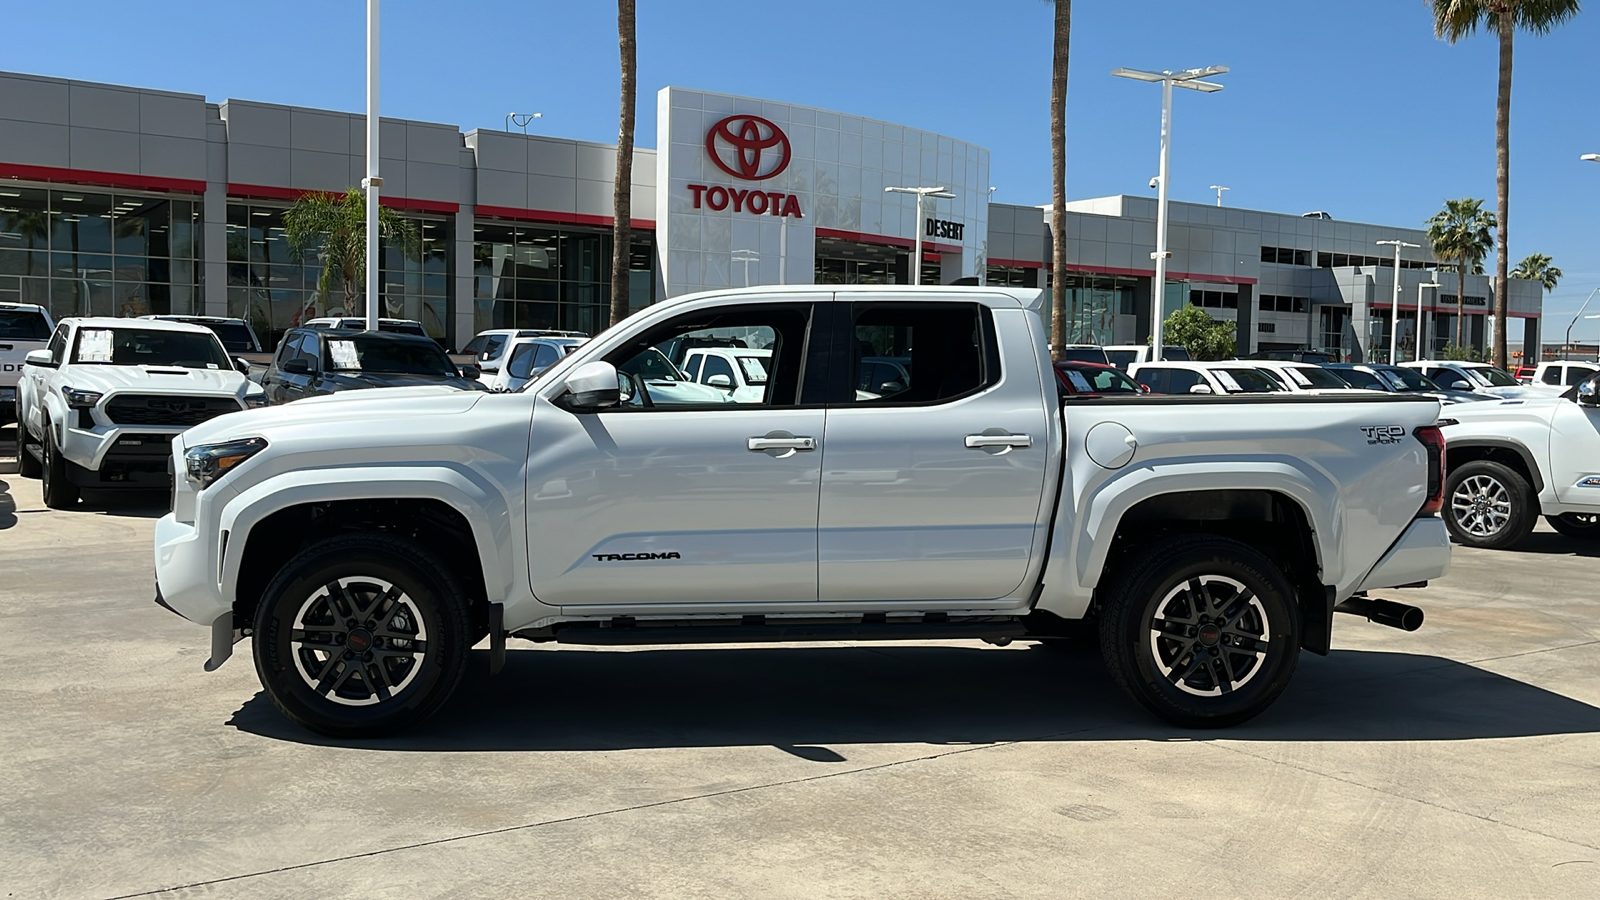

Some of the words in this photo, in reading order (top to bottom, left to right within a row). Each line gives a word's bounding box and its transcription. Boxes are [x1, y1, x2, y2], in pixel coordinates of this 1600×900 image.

[687, 184, 803, 218] TOYOTA
[926, 218, 965, 241] DESERT
[1360, 425, 1406, 440] TRD
[592, 552, 681, 561] TACOMA
